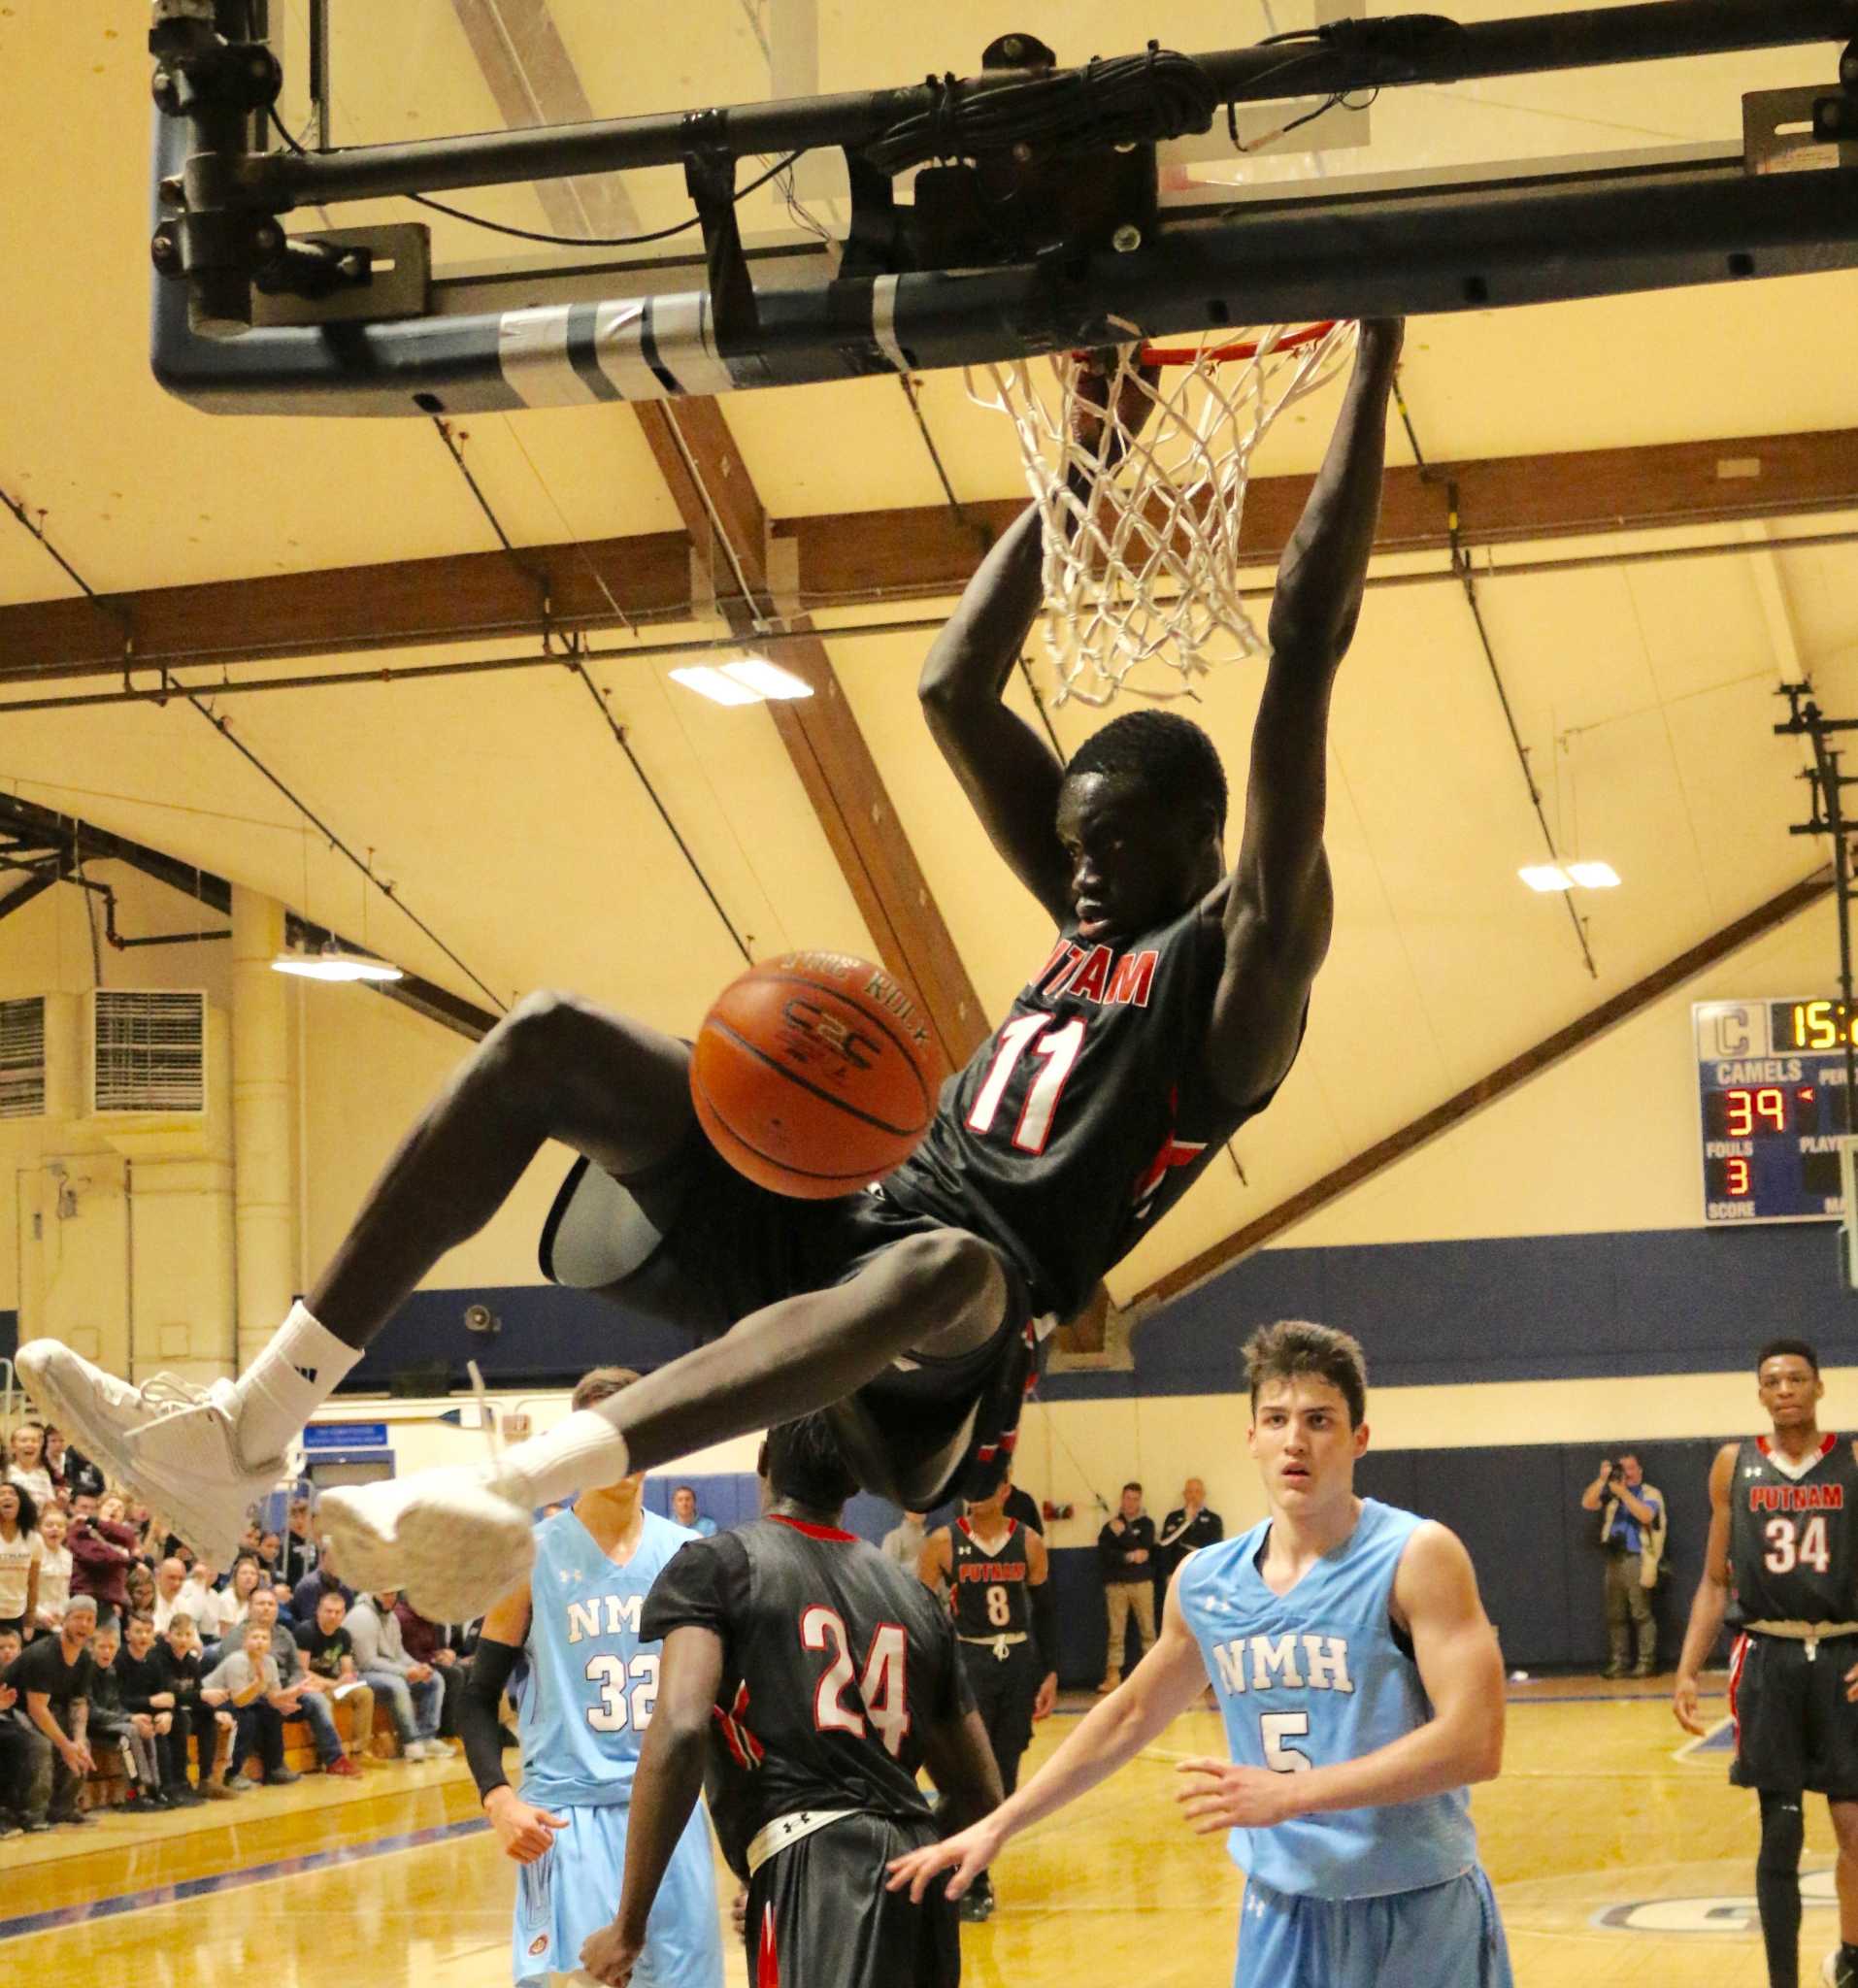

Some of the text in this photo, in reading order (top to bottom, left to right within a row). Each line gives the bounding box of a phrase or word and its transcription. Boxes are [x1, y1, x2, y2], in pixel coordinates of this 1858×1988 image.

[1716, 1008, 1749, 1057] C
[964, 1011, 1088, 1156] 11
[1715, 1058, 1803, 1085] CAMELS
[1727, 1088, 1785, 1137] 39
[1706, 1140, 1753, 1158] FOULS
[1728, 1159, 1749, 1195] 3
[1749, 1483, 1843, 1512] PUTNAM
[1764, 1515, 1831, 1574] 34
[959, 1562, 1026, 1583] PUTNAM
[566, 1594, 643, 1645] NM
[985, 1584, 1011, 1627] 8
[799, 1603, 912, 1760] 24
[1212, 1634, 1355, 1696] NMH
[584, 1653, 661, 1733] 32
[1259, 1710, 1313, 1774] 5
